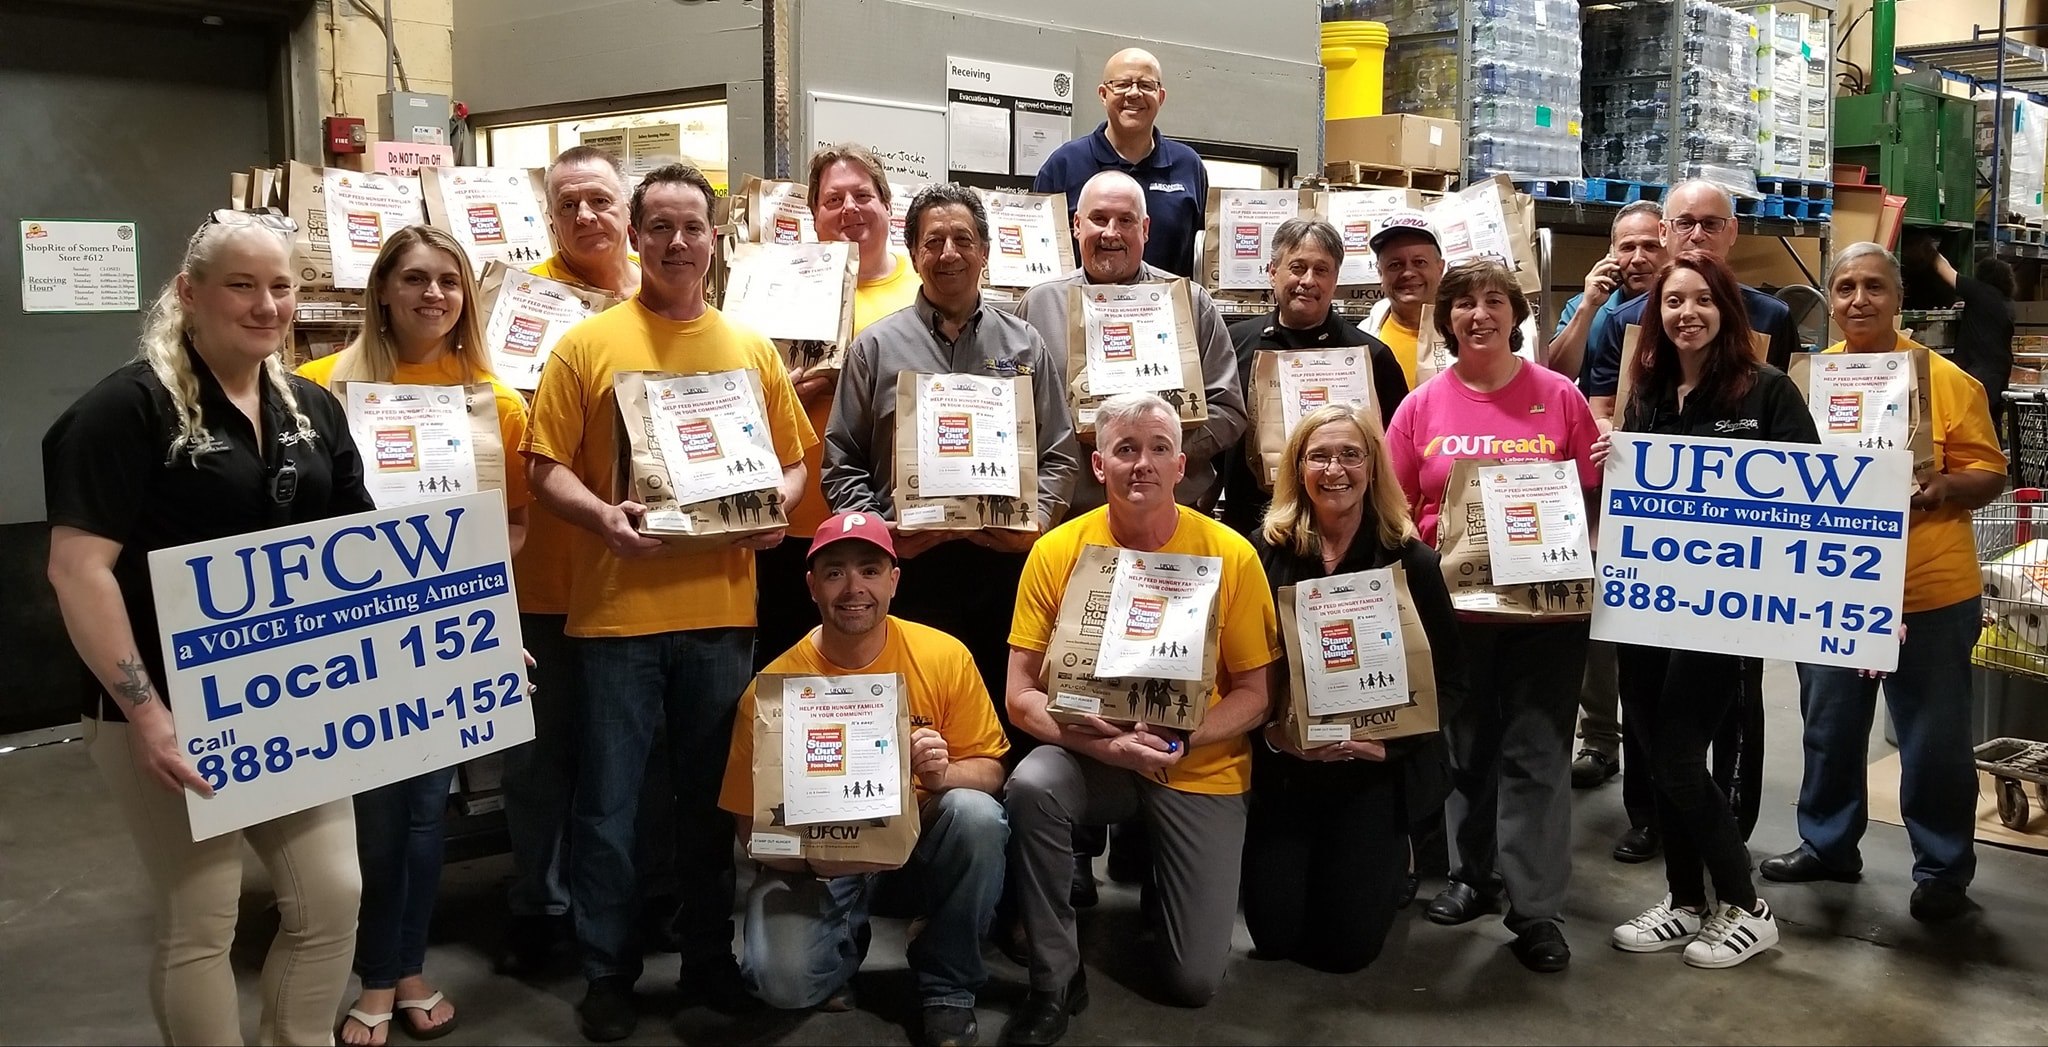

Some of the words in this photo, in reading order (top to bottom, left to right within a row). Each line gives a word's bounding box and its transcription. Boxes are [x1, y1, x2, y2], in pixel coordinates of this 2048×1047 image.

[951, 65, 992, 82] Receiving
[959, 92, 988, 103] Evacuation
[989, 96, 1001, 106] Map
[1015, 100, 1040, 109] Approved
[1040, 102, 1063, 111] Chemical
[388, 152, 398, 163] Do
[399, 152, 414, 164] NOT
[414, 154, 430, 165] Turn
[431, 155, 441, 166] Off
[883, 163, 896, 172] hen
[995, 185, 1016, 194] Meeting
[471, 226, 503, 235] Hunger
[476, 222, 495, 230] Out
[26, 243, 66, 253] ShopRite
[68, 243, 77, 251] of
[79, 244, 109, 252] Somers
[112, 244, 134, 252] Point
[29, 276, 67, 285] Receiving
[1351, 289, 1385, 299] UFCW
[510, 323, 542, 337] Stamp
[506, 334, 539, 347] Hunger
[514, 333, 535, 341] Out
[1103, 335, 1131, 343] Stamp
[715, 396, 741, 404] FAMILIES
[1300, 399, 1327, 407] Stamp
[938, 426, 970, 435] Stamp
[1714, 419, 1759, 432] ShopRite
[680, 431, 714, 442] Stamp
[687, 438, 710, 446] Out
[376, 440, 413, 449] Stamp
[682, 442, 718, 453] Hunger
[938, 438, 970, 447] Hunger
[1440, 433, 1556, 455] OUTreach
[376, 452, 416, 461] Hunger
[1631, 440, 1875, 505] UFCW
[1612, 499, 1624, 510] a
[1628, 496, 1697, 516] VOICE
[1701, 501, 1729, 518] for
[1734, 507, 1812, 529] working
[1816, 514, 1900, 532] America
[842, 513, 867, 533] P
[1505, 516, 1536, 525] Stamp
[1506, 527, 1539, 535] Hunger
[1620, 525, 1763, 570] Local
[1784, 539, 1882, 581] 152
[185, 507, 466, 620] UFCW
[1602, 564, 1638, 580] Call
[1158, 578, 1181, 586] HUNGRY
[1359, 597, 1383, 605] FAMILIES
[1129, 606, 1162, 617] Stamp
[1602, 580, 1894, 635] 888-JOIN-152
[179, 644, 194, 660] a
[199, 617, 288, 650] VOICE
[294, 613, 326, 635] for
[332, 594, 420, 627] working
[424, 572, 505, 604] America
[1135, 615, 1156, 623] Out
[1127, 619, 1159, 630] Hunger
[1321, 637, 1353, 646] Stamp
[1820, 636, 1856, 656] NJ
[1323, 649, 1355, 659] Hunger
[200, 637, 378, 722] Local
[399, 608, 500, 668] 152
[1352, 711, 1396, 729] UFCW
[196, 672, 523, 791] 888-JOIN-152
[460, 720, 495, 749] NJ
[187, 728, 236, 755] Call
[807, 740, 843, 749] Stamp
[806, 754, 843, 763] Hunger
[809, 825, 860, 840] UFCW
